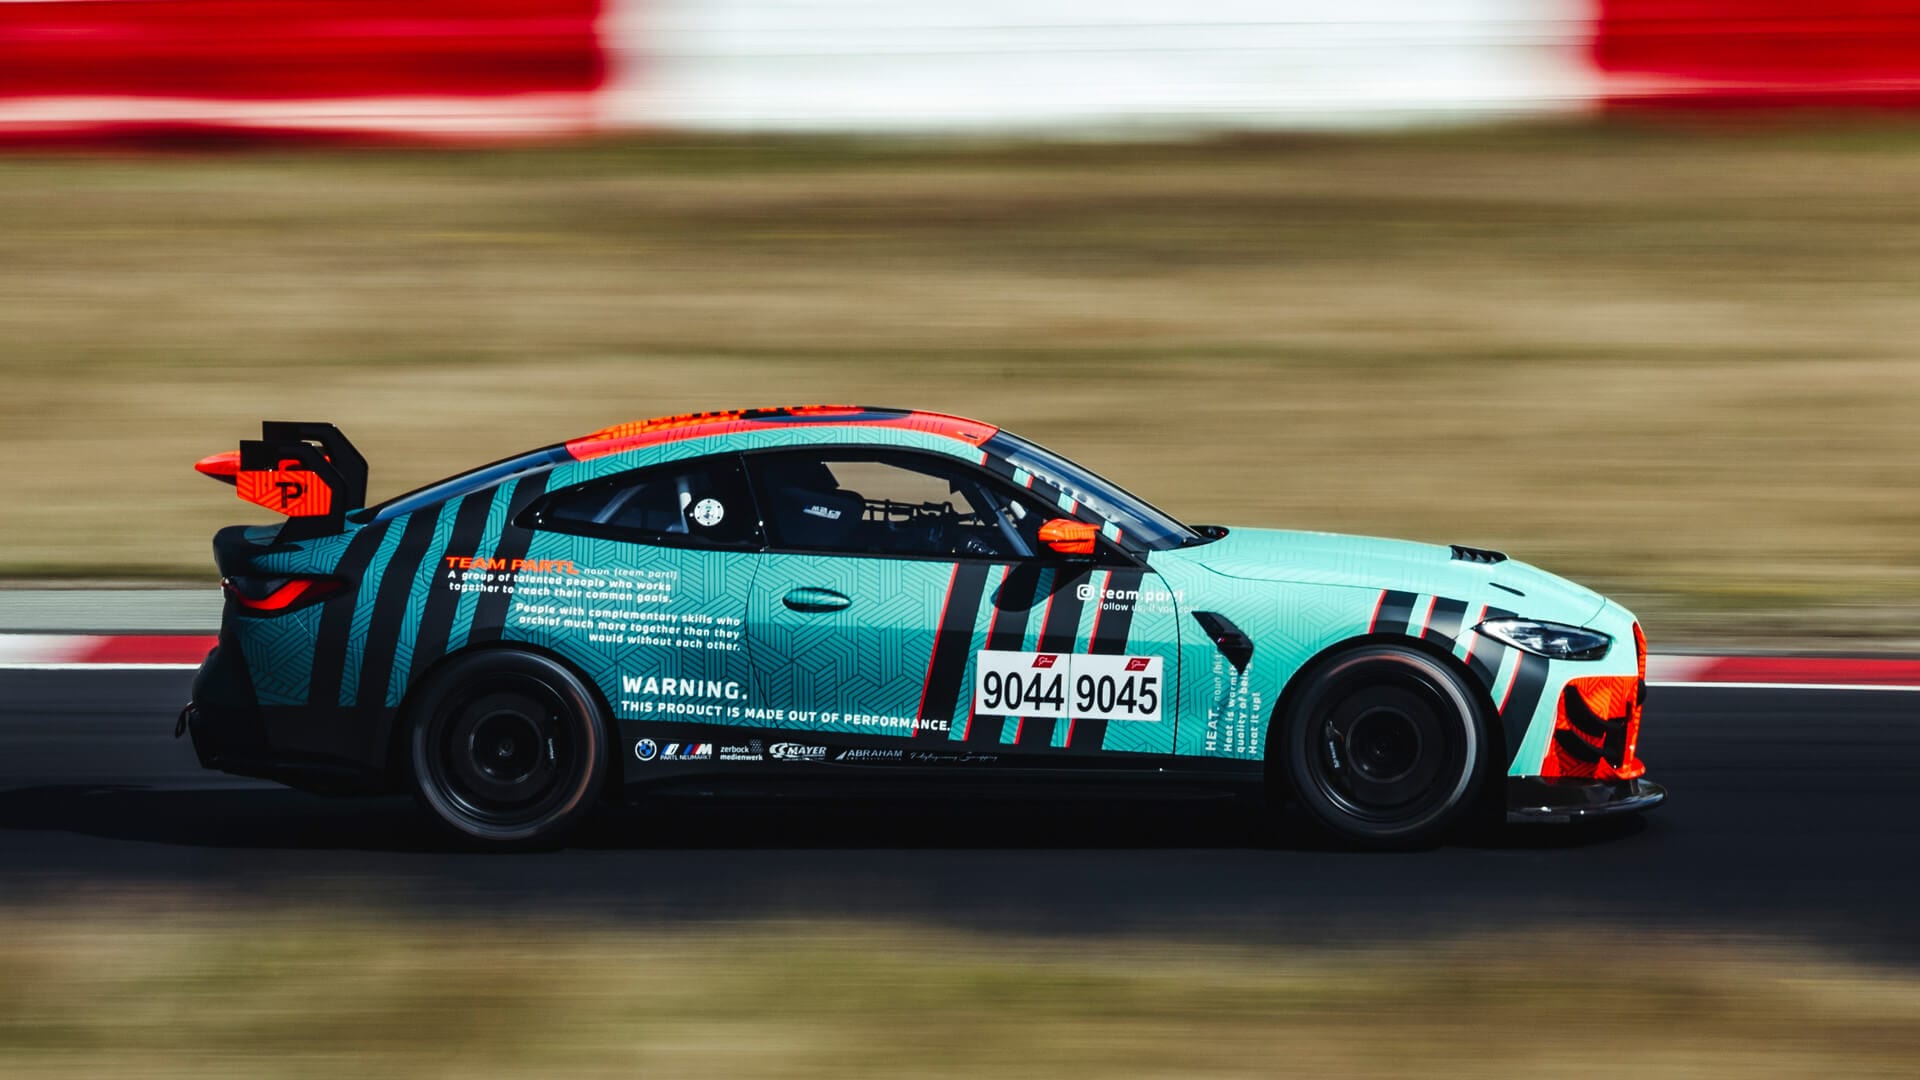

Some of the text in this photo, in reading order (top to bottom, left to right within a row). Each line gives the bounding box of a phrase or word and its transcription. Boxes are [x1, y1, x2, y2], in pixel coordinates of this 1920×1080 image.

[446, 556, 506, 570] TEAM
[511, 559, 579, 575] PARTL
[584, 568, 610, 576] noun
[448, 570, 671, 592] A group of talented people who works
[449, 582, 673, 604] together to reach their common goals.
[516, 603, 741, 626] People with complementary skills who
[1099, 602, 1129, 611] follow
[564, 619, 594, 629] much
[598, 621, 627, 631] more
[630, 622, 680, 635] together
[684, 626, 710, 636] than
[714, 628, 740, 640] they
[589, 633, 741, 651] would without each other.
[622, 675, 748, 700] WARNING.
[983, 670, 1065, 711] 9044
[1076, 674, 1158, 715] 9045
[1205, 706, 1221, 751] HEAT.
[1214, 677, 1222, 701] noun
[1238, 697, 1247, 709] of
[620, 700, 951, 731] THIS PRODUCT IS MADE OUT OF PERFORMANCE.
[1225, 711, 1234, 721] is
[1249, 692, 1262, 754] Heat it up!
[1224, 724, 1233, 752] Heat
[1236, 712, 1247, 753] quality
[720, 745, 749, 753] zerbock
[720, 753, 763, 761] medienwerk
[787, 746, 827, 755] MAYER
[847, 749, 903, 757] ABRAHAM
